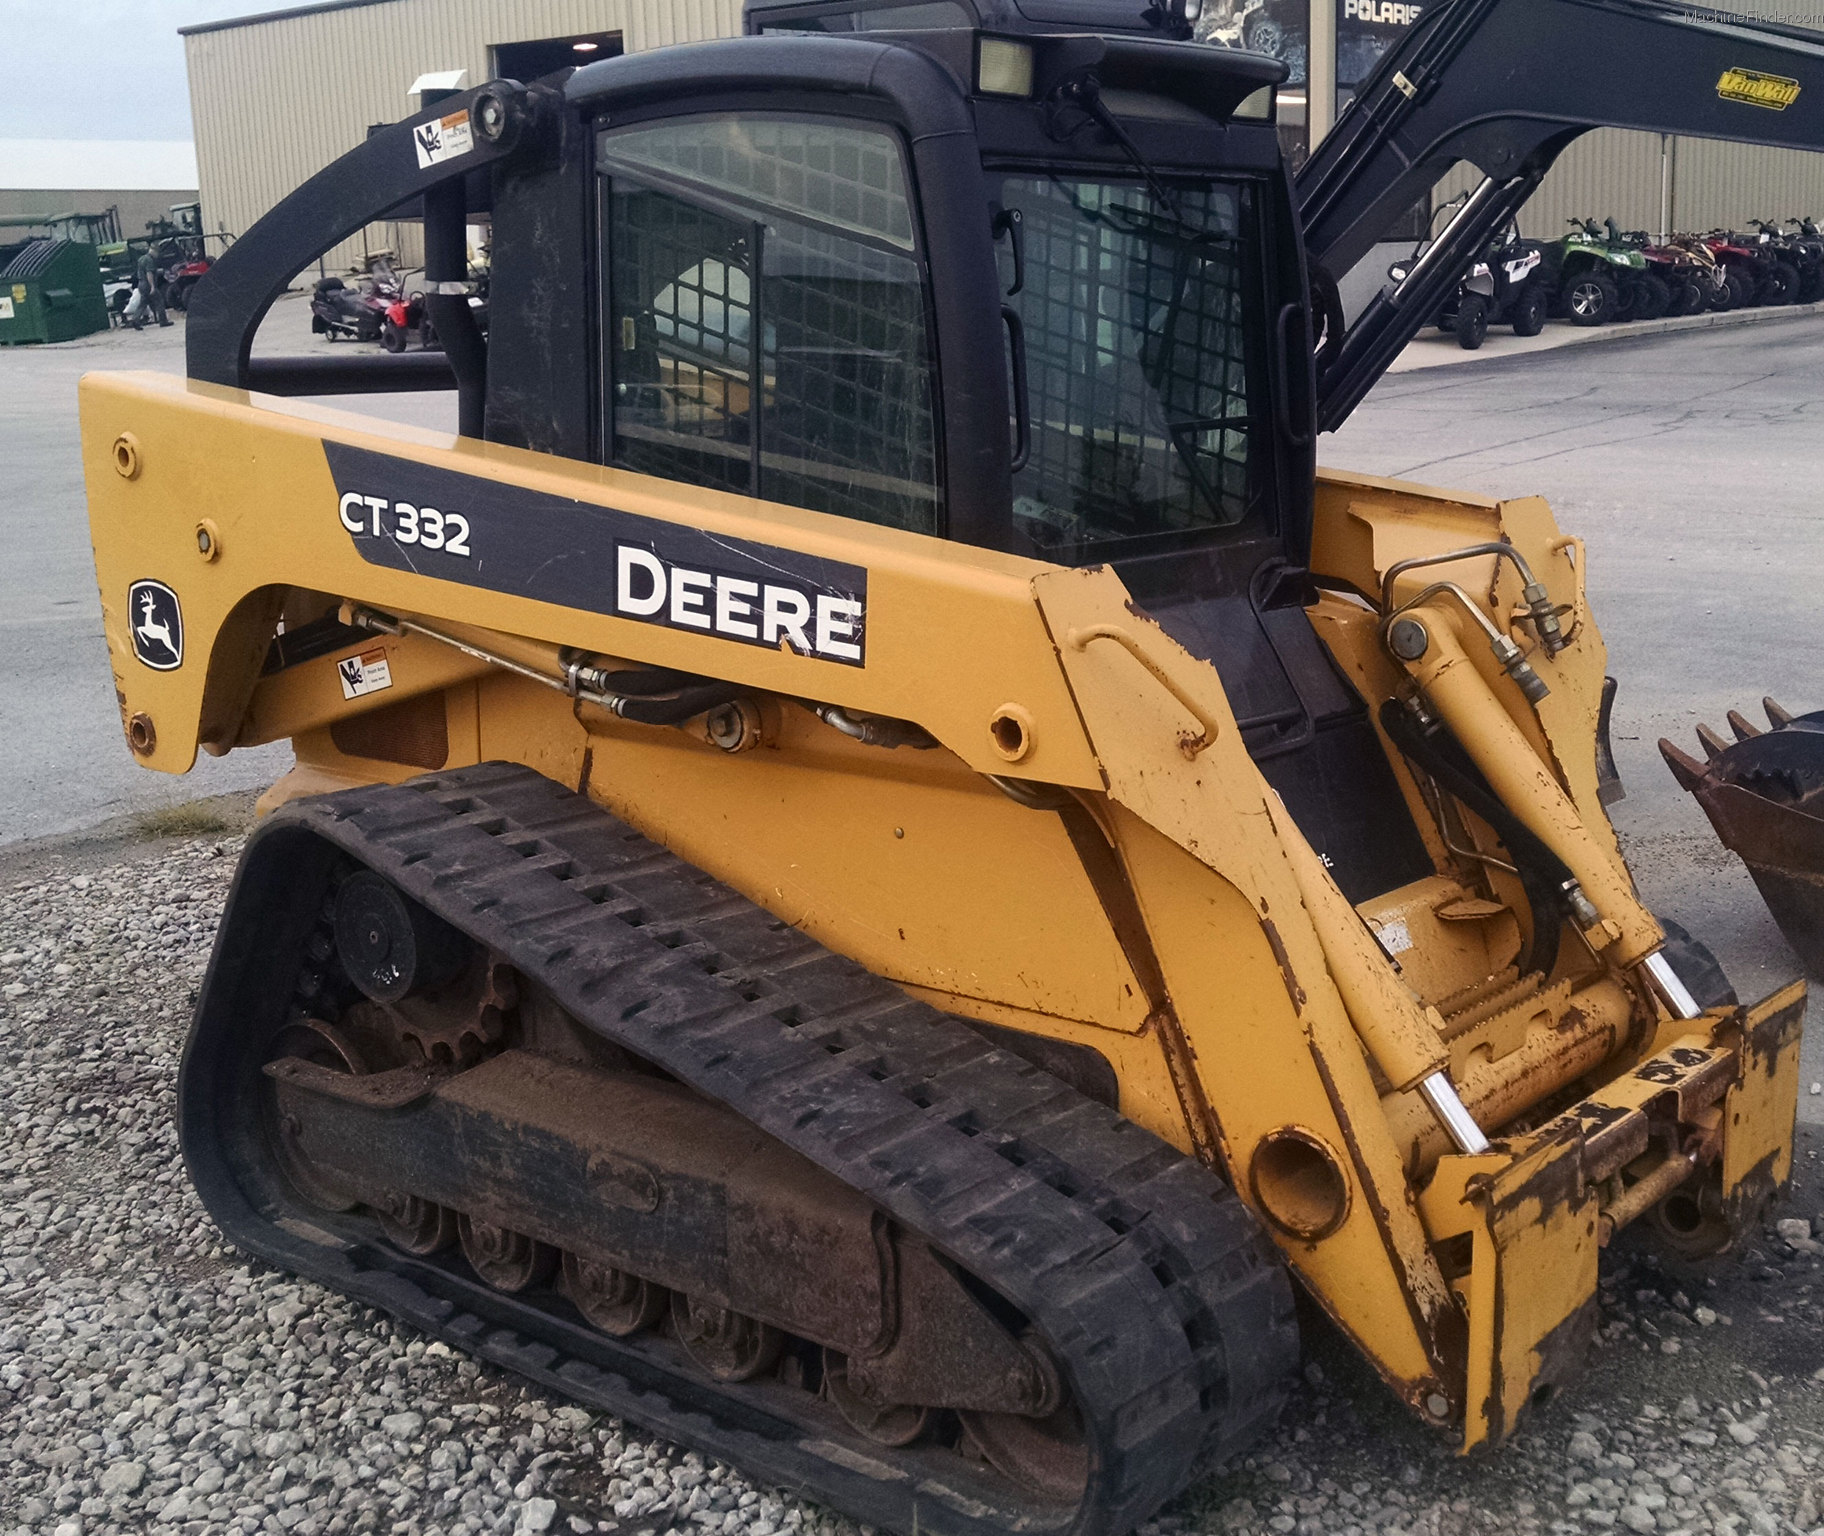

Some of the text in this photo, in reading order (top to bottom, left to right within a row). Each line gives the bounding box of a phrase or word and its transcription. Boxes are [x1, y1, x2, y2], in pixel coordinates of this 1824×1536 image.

[1344, 0, 1423, 26] POLARIS
[339, 492, 470, 556] CT 332
[617, 545, 862, 660] DEERE
